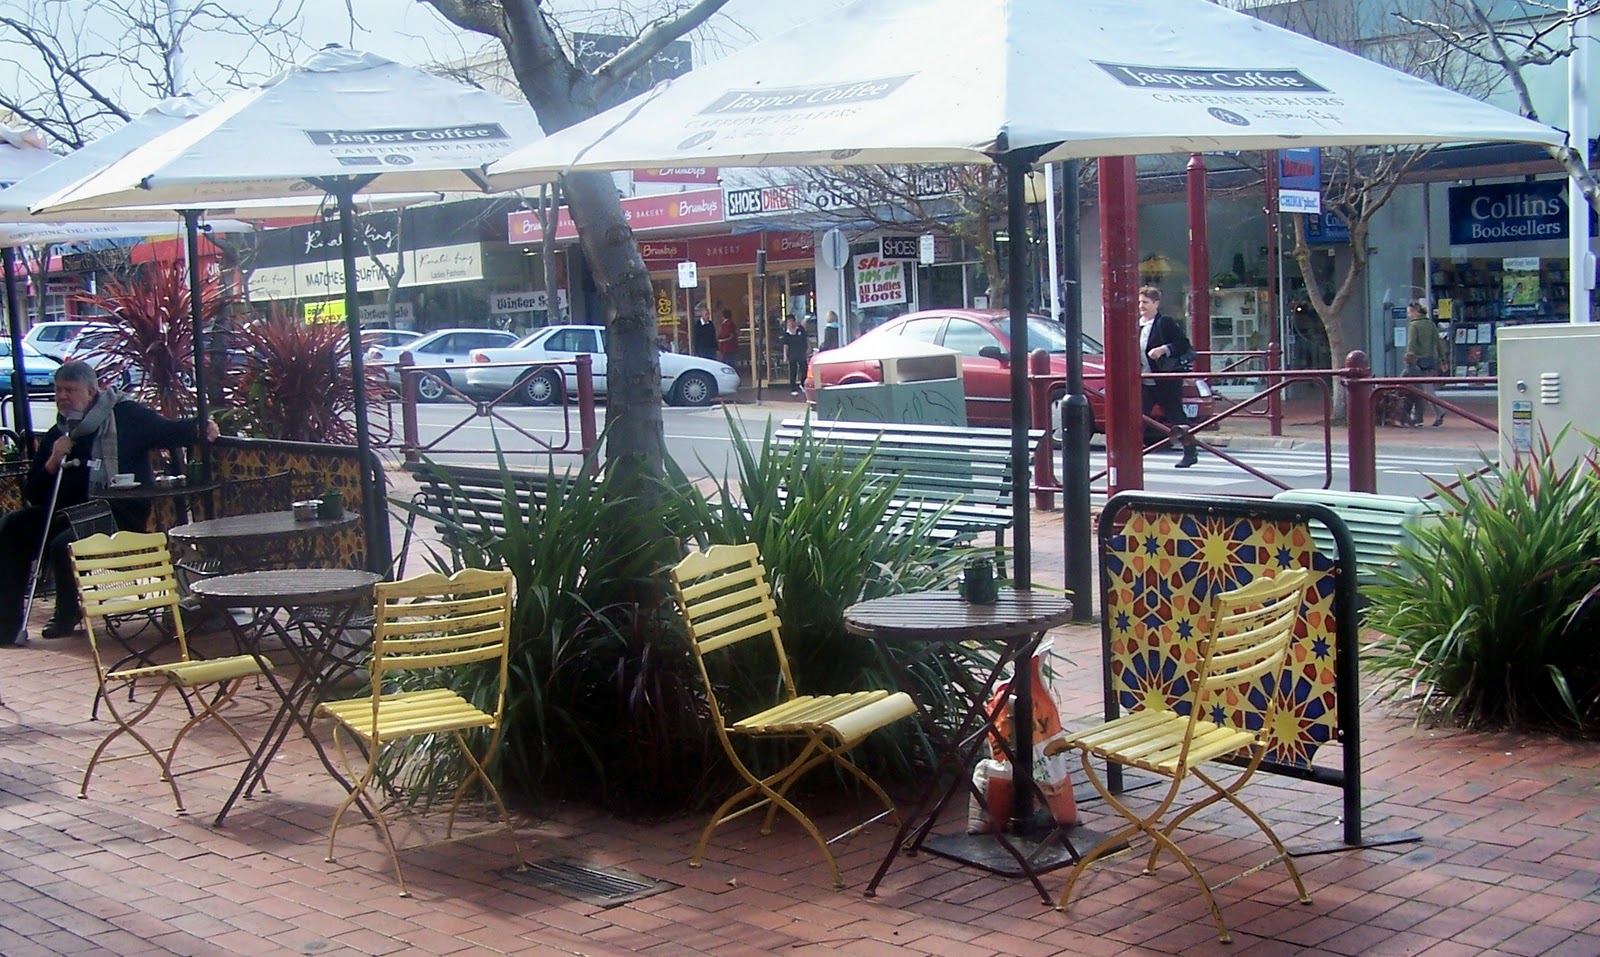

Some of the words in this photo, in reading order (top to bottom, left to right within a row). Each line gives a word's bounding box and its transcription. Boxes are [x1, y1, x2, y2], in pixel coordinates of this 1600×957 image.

[1118, 67, 1214, 89] Jasper
[1212, 72, 1304, 88] Coffee
[717, 92, 805, 112] Jasper
[806, 80, 889, 104] Coffee
[1152, 93, 1254, 105] CAFFEINE
[1255, 96, 1345, 107] DEALERS
[325, 131, 405, 146] Jasper
[410, 127, 490, 141] Coffee
[329, 145, 420, 155] CAFFEINE
[427, 141, 510, 152] DEALERS
[636, 208, 664, 219] BAKERY
[679, 199, 718, 217] Brumby's
[729, 190, 761, 214] SHOES
[762, 186, 799, 210] DIRECT
[1470, 192, 1561, 220] Collins
[1471, 219, 1562, 239] Booksellers
[642, 244, 678, 257] Brumby's
[706, 245, 740, 256] BAKERY
[883, 240, 916, 256] SHOES
[355, 263, 397, 282] SURFWEA
[858, 268, 881, 285] 30%
[884, 264, 900, 281] off
[858, 284, 871, 296] All
[872, 280, 902, 292] Ladies
[859, 290, 902, 304] Boots
[497, 297, 536, 310] Winter
